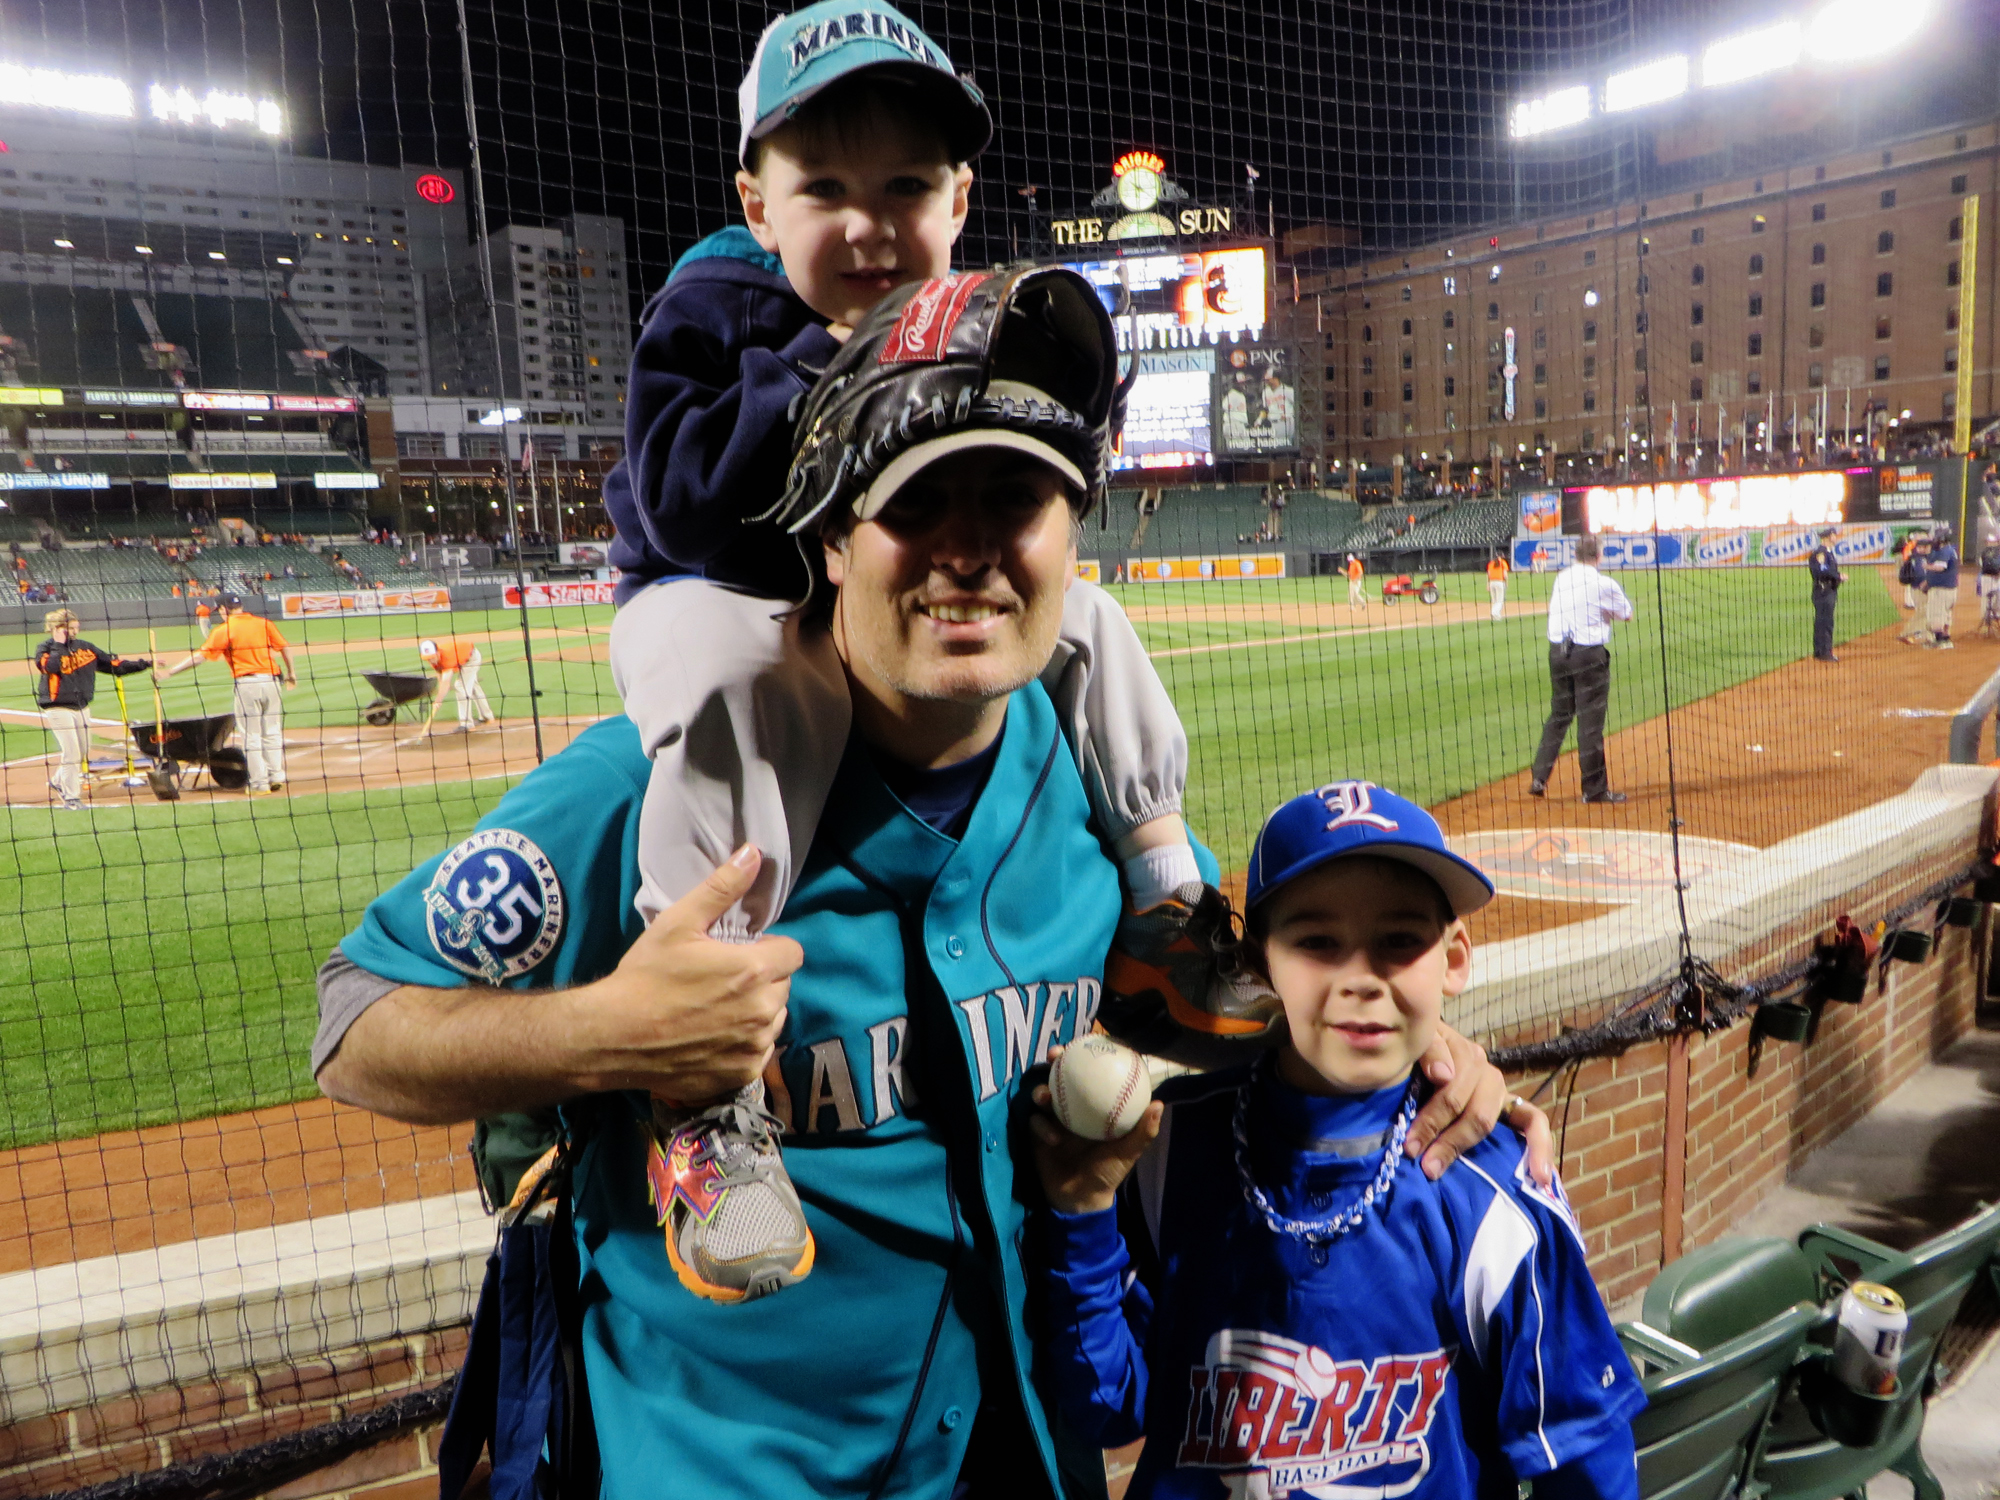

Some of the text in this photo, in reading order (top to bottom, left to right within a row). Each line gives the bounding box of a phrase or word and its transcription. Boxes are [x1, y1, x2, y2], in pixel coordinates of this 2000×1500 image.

[1112, 151, 1165, 177] ORIOLES
[1052, 207, 1231, 245] THE SUN
[1250, 349, 1285, 366] PNC
[61, 473, 109, 488] UNION
[1536, 538, 1656, 565] GECO
[1700, 536, 1743, 560] Gulf
[1764, 534, 1811, 558] Gulf
[1834, 530, 1885, 557] Gulf
[551, 585, 589, 604] State
[1316, 779, 1399, 832] L
[441, 830, 529, 877] SEATTLE
[456, 854, 544, 946] 35
[516, 856, 561, 970] MARINERS
[1176, 1347, 1456, 1468] LIBERTY
